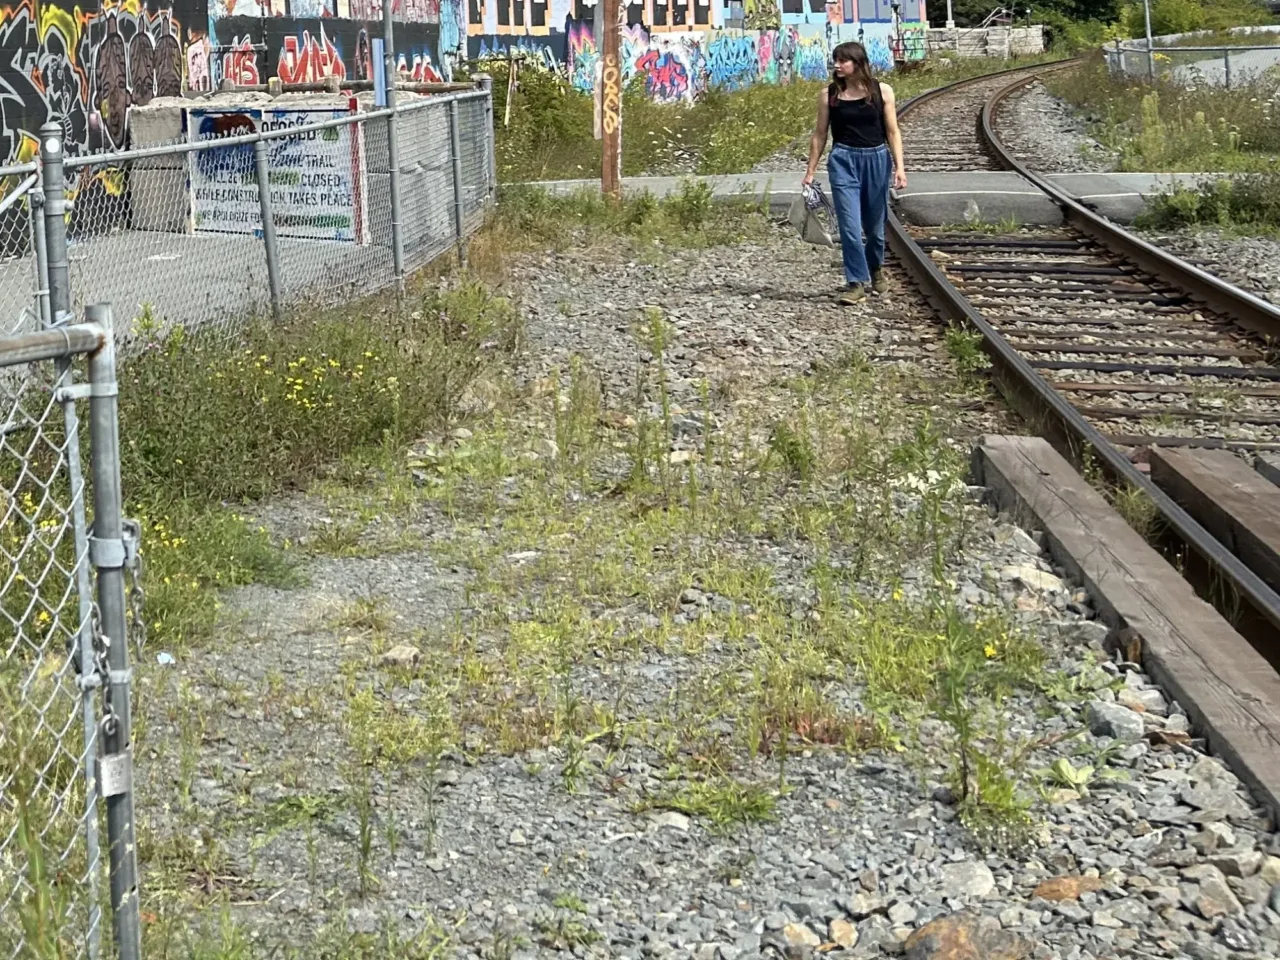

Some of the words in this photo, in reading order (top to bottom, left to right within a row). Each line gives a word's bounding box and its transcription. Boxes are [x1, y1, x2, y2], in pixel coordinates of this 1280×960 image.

[301, 173, 341, 187] CLOSED
[288, 191, 319, 206] TAKES
[320, 193, 353, 207] PLACE
